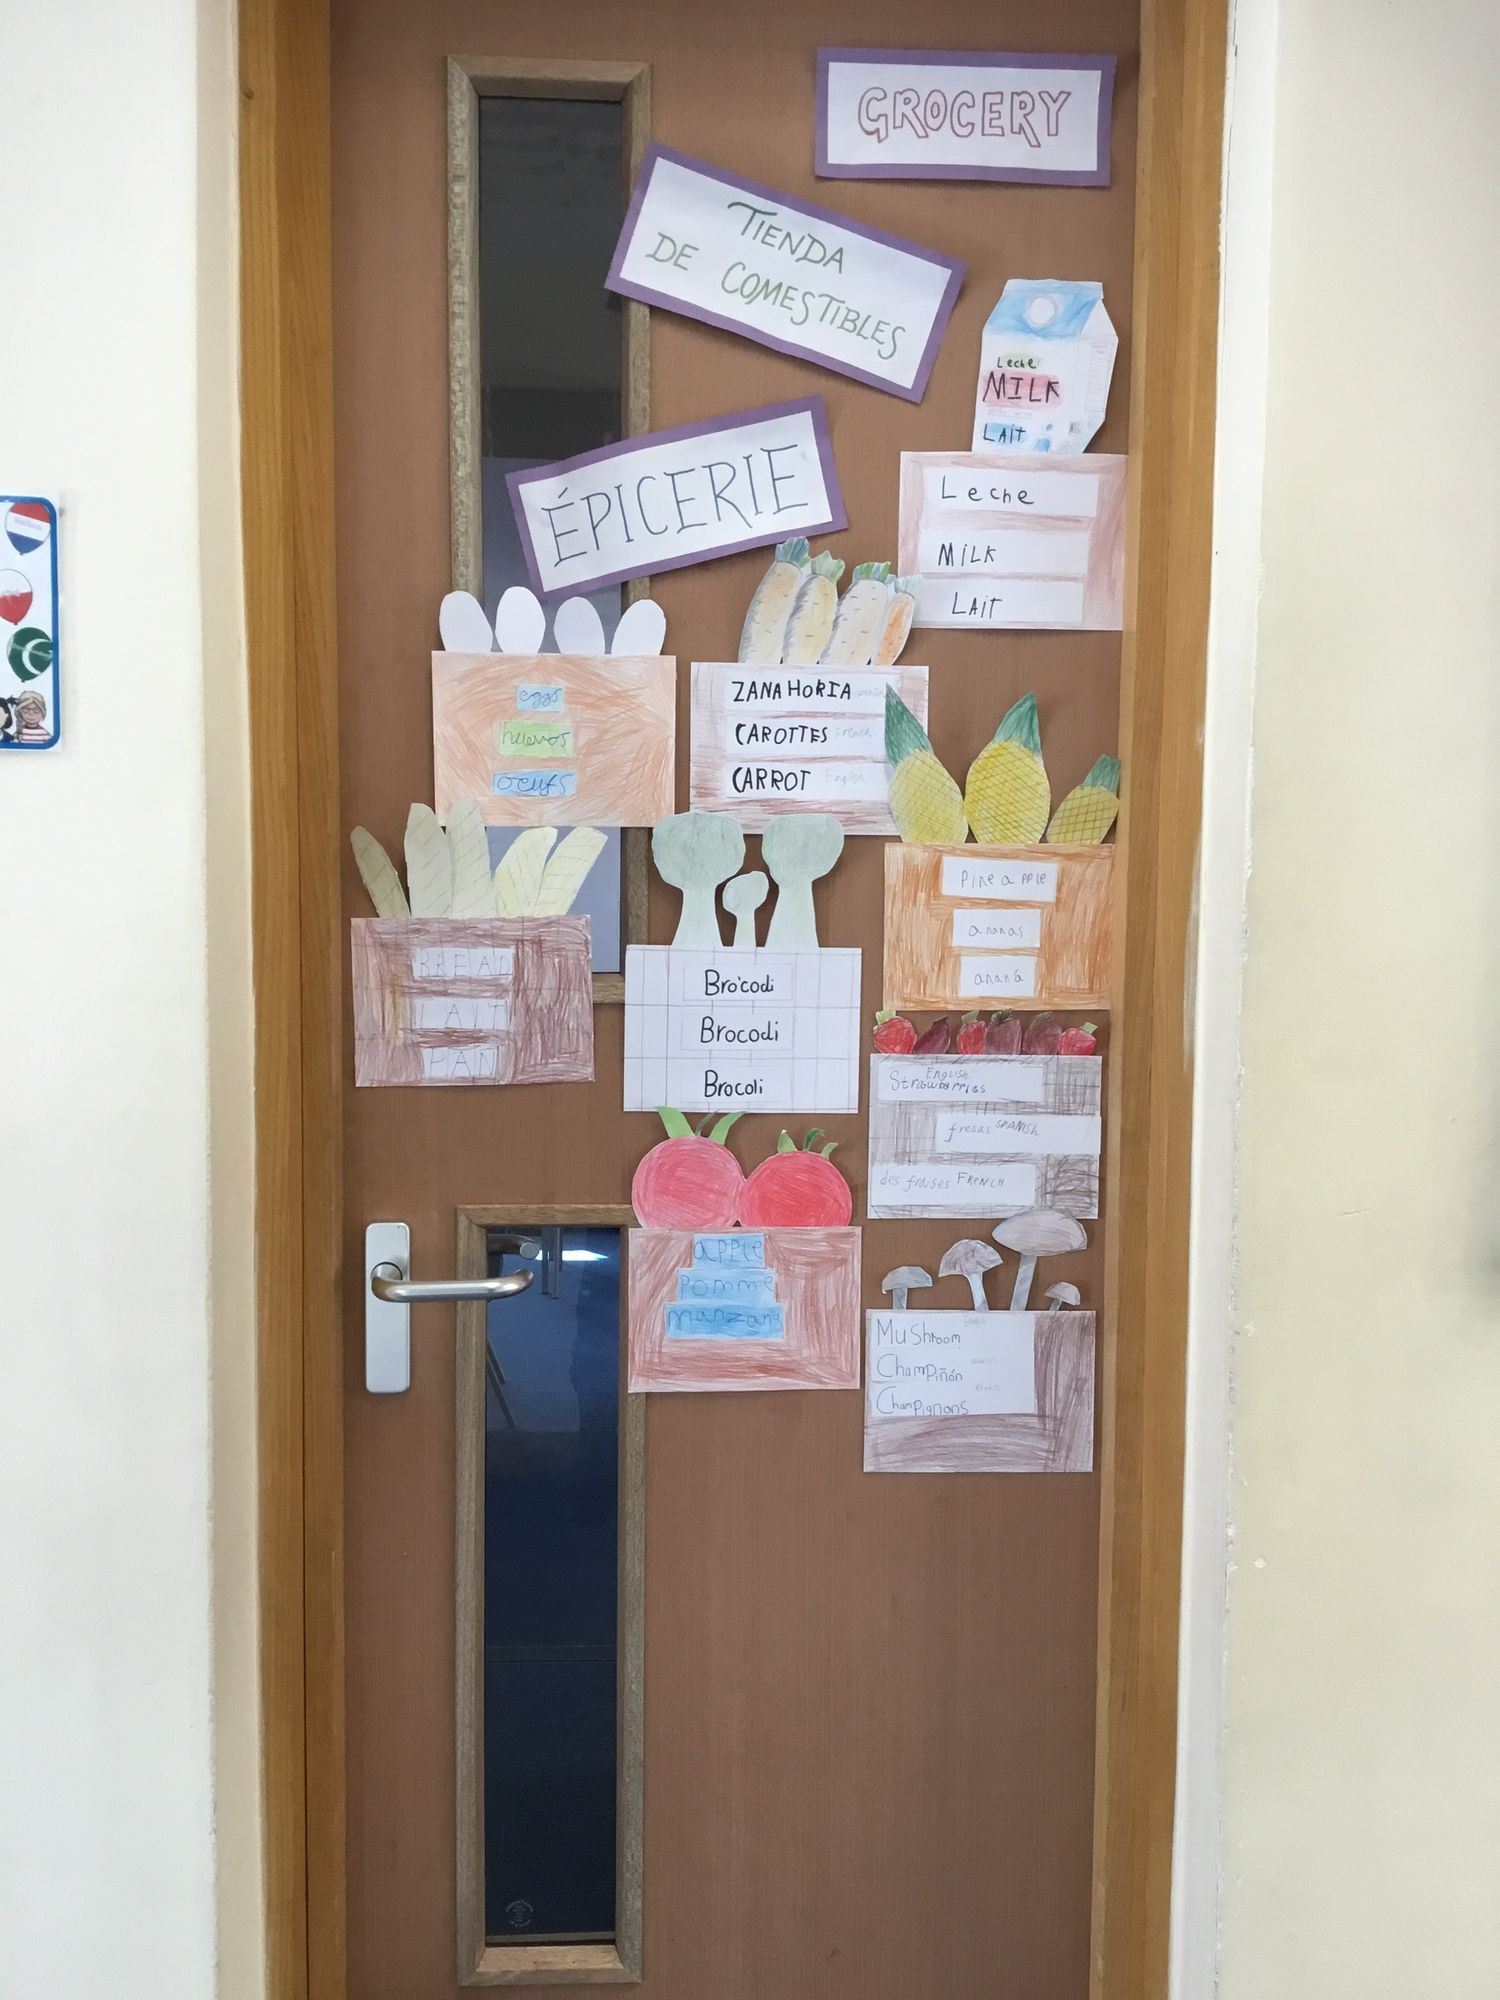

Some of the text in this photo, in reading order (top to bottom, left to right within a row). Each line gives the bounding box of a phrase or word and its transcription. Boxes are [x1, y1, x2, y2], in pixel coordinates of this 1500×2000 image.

[858, 86, 1071, 148] GROCERY
[727, 202, 844, 274] TIENDA
[645, 232, 906, 360] DE COMESTIBLES
[997, 356, 1038, 370] Leche
[982, 371, 1060, 403] MILK
[941, 475, 1035, 505] Leche
[541, 444, 809, 568] ÉPICERIE
[735, 723, 828, 745] CAROTTES
[732, 767, 811, 793] CARROT
[968, 924, 1023, 938] ananas
[704, 1069, 763, 1097] Brocoli
